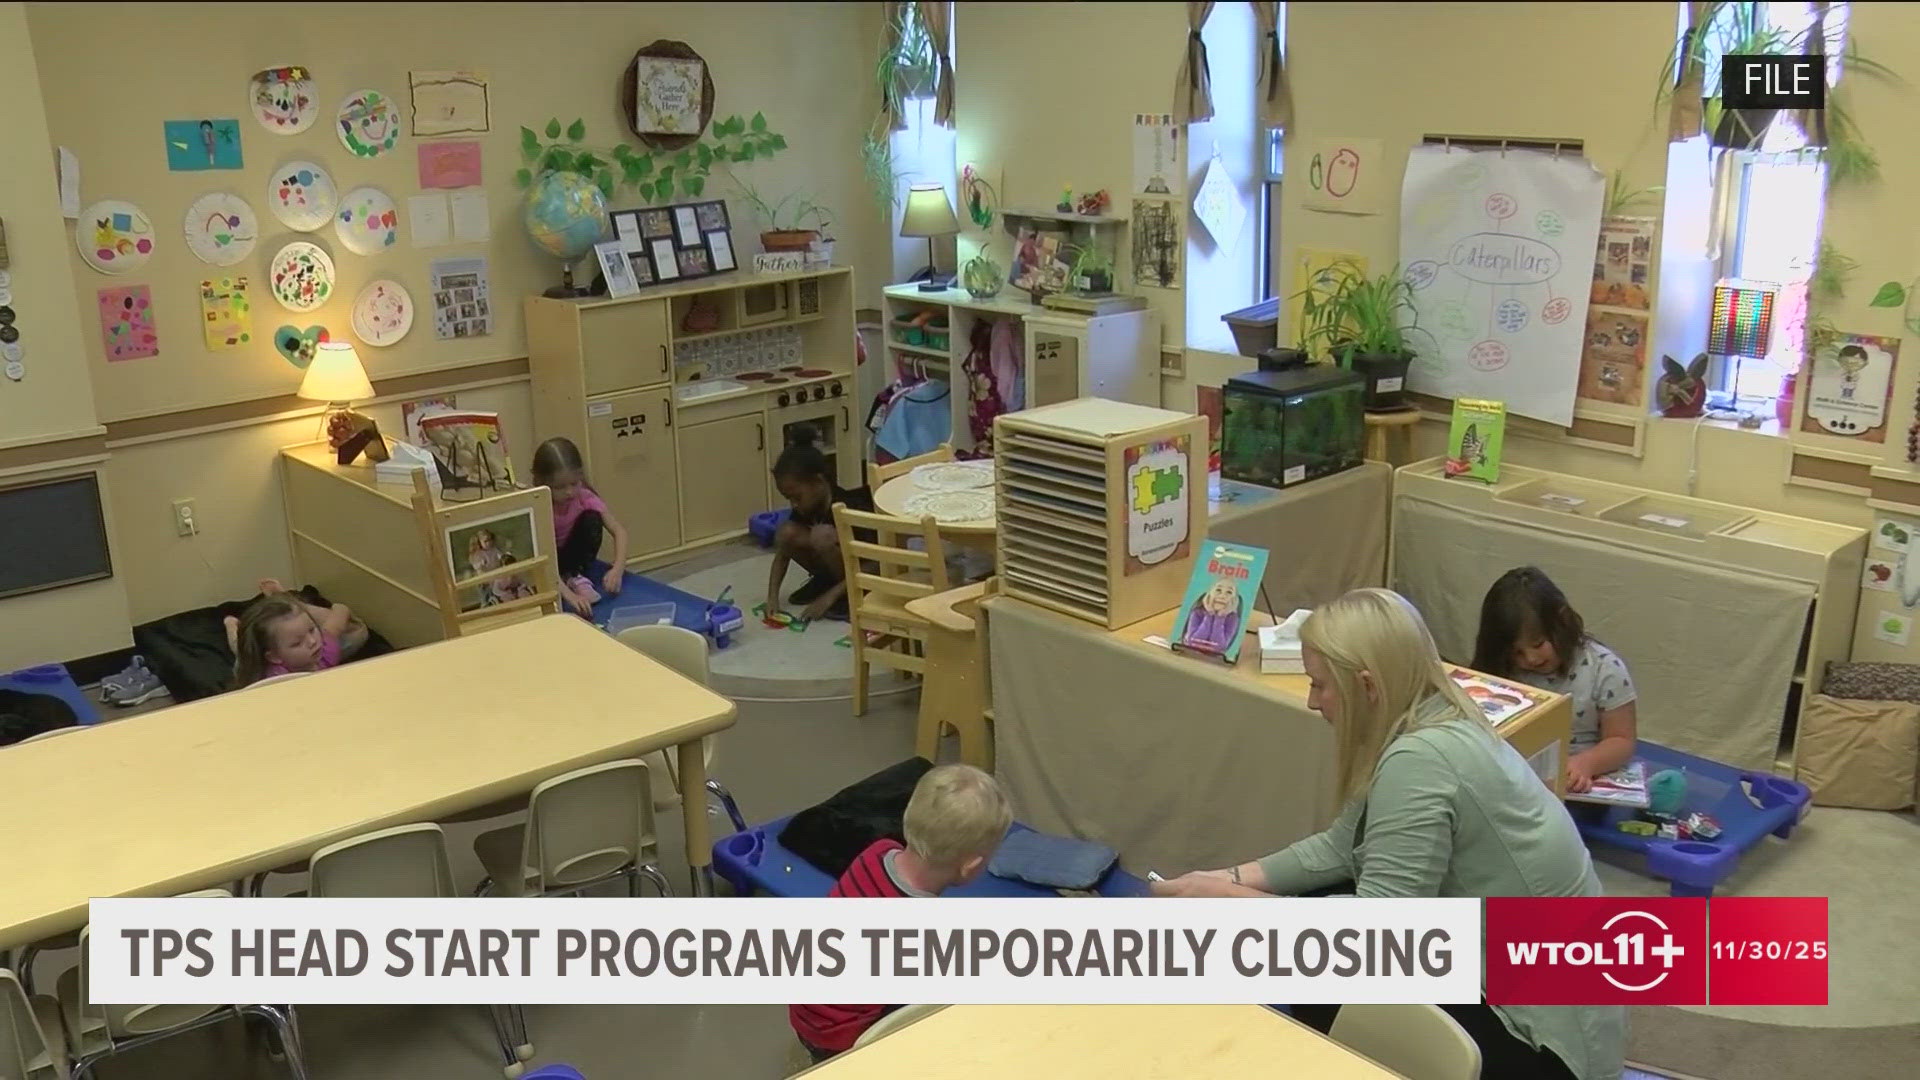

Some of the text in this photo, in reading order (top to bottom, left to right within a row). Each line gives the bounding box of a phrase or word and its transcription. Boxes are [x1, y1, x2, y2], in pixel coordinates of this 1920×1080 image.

[1452, 243, 1553, 279] Caterpillars
[1143, 518, 1174, 533] Puzzles
[1208, 559, 1249, 579] Brain
